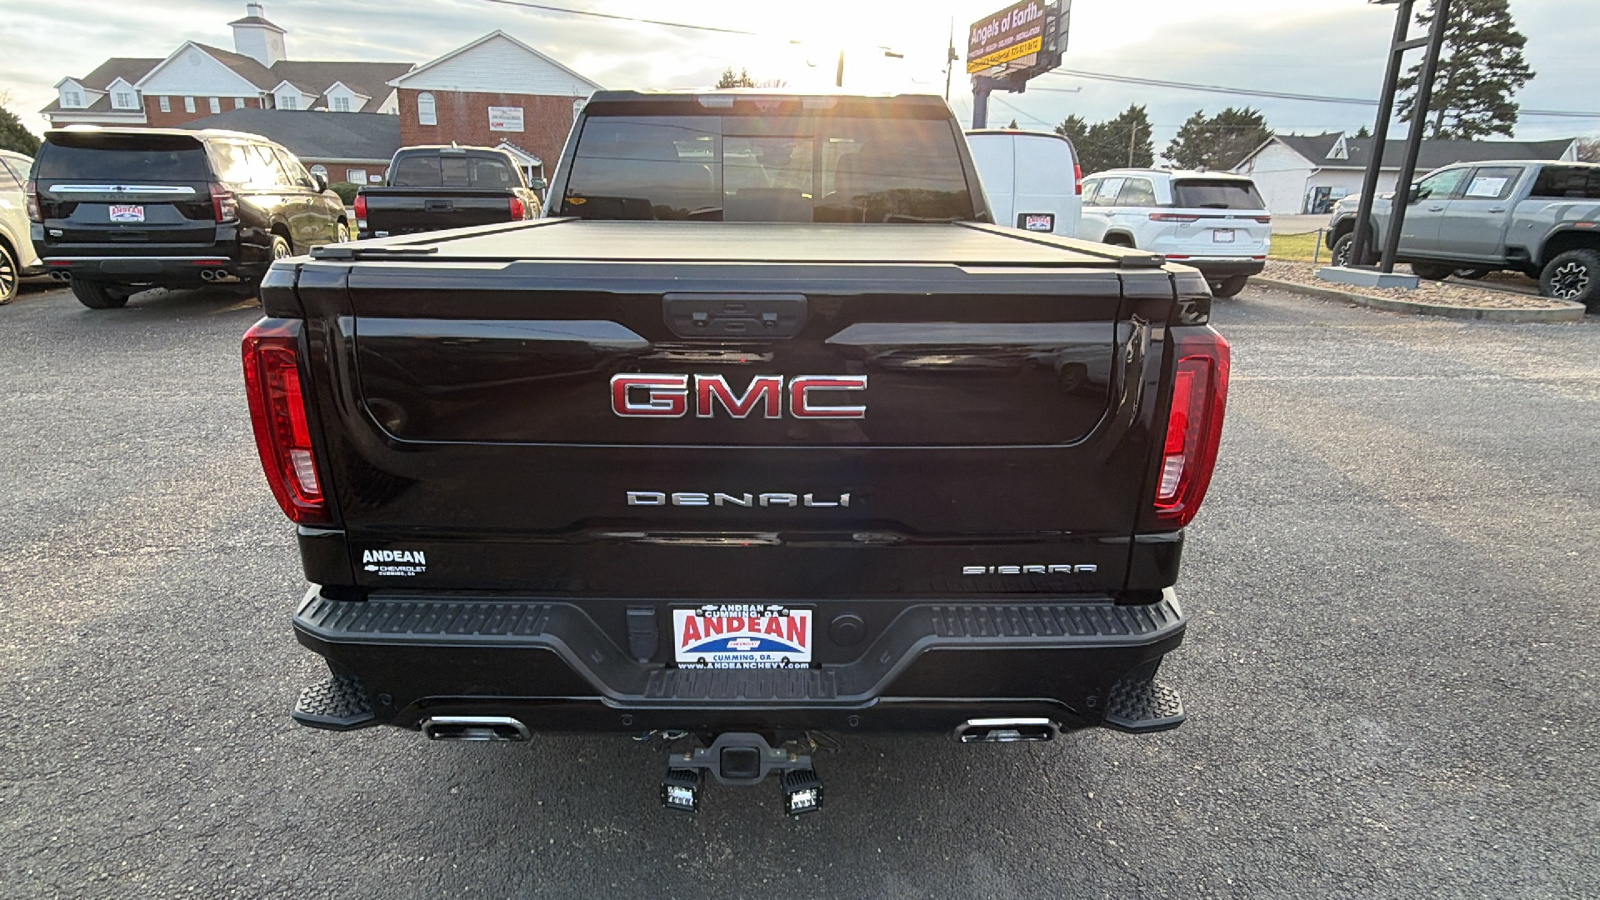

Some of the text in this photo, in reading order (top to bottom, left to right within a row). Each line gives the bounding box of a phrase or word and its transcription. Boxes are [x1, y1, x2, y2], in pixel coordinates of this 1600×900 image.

[971, 19, 999, 45] Angels
[1001, 12, 1011, 32] of
[610, 373, 868, 419] GMC
[626, 491, 850, 507] DENALI
[363, 550, 425, 564] ANDEAN
[962, 564, 1098, 575] SIERRA
[719, 604, 764, 612] ANDEAN
[681, 615, 807, 649] ANDEAN
[677, 661, 809, 669] www.ANDEANCHEVY.com
[712, 654, 758, 662] CUMMING,
